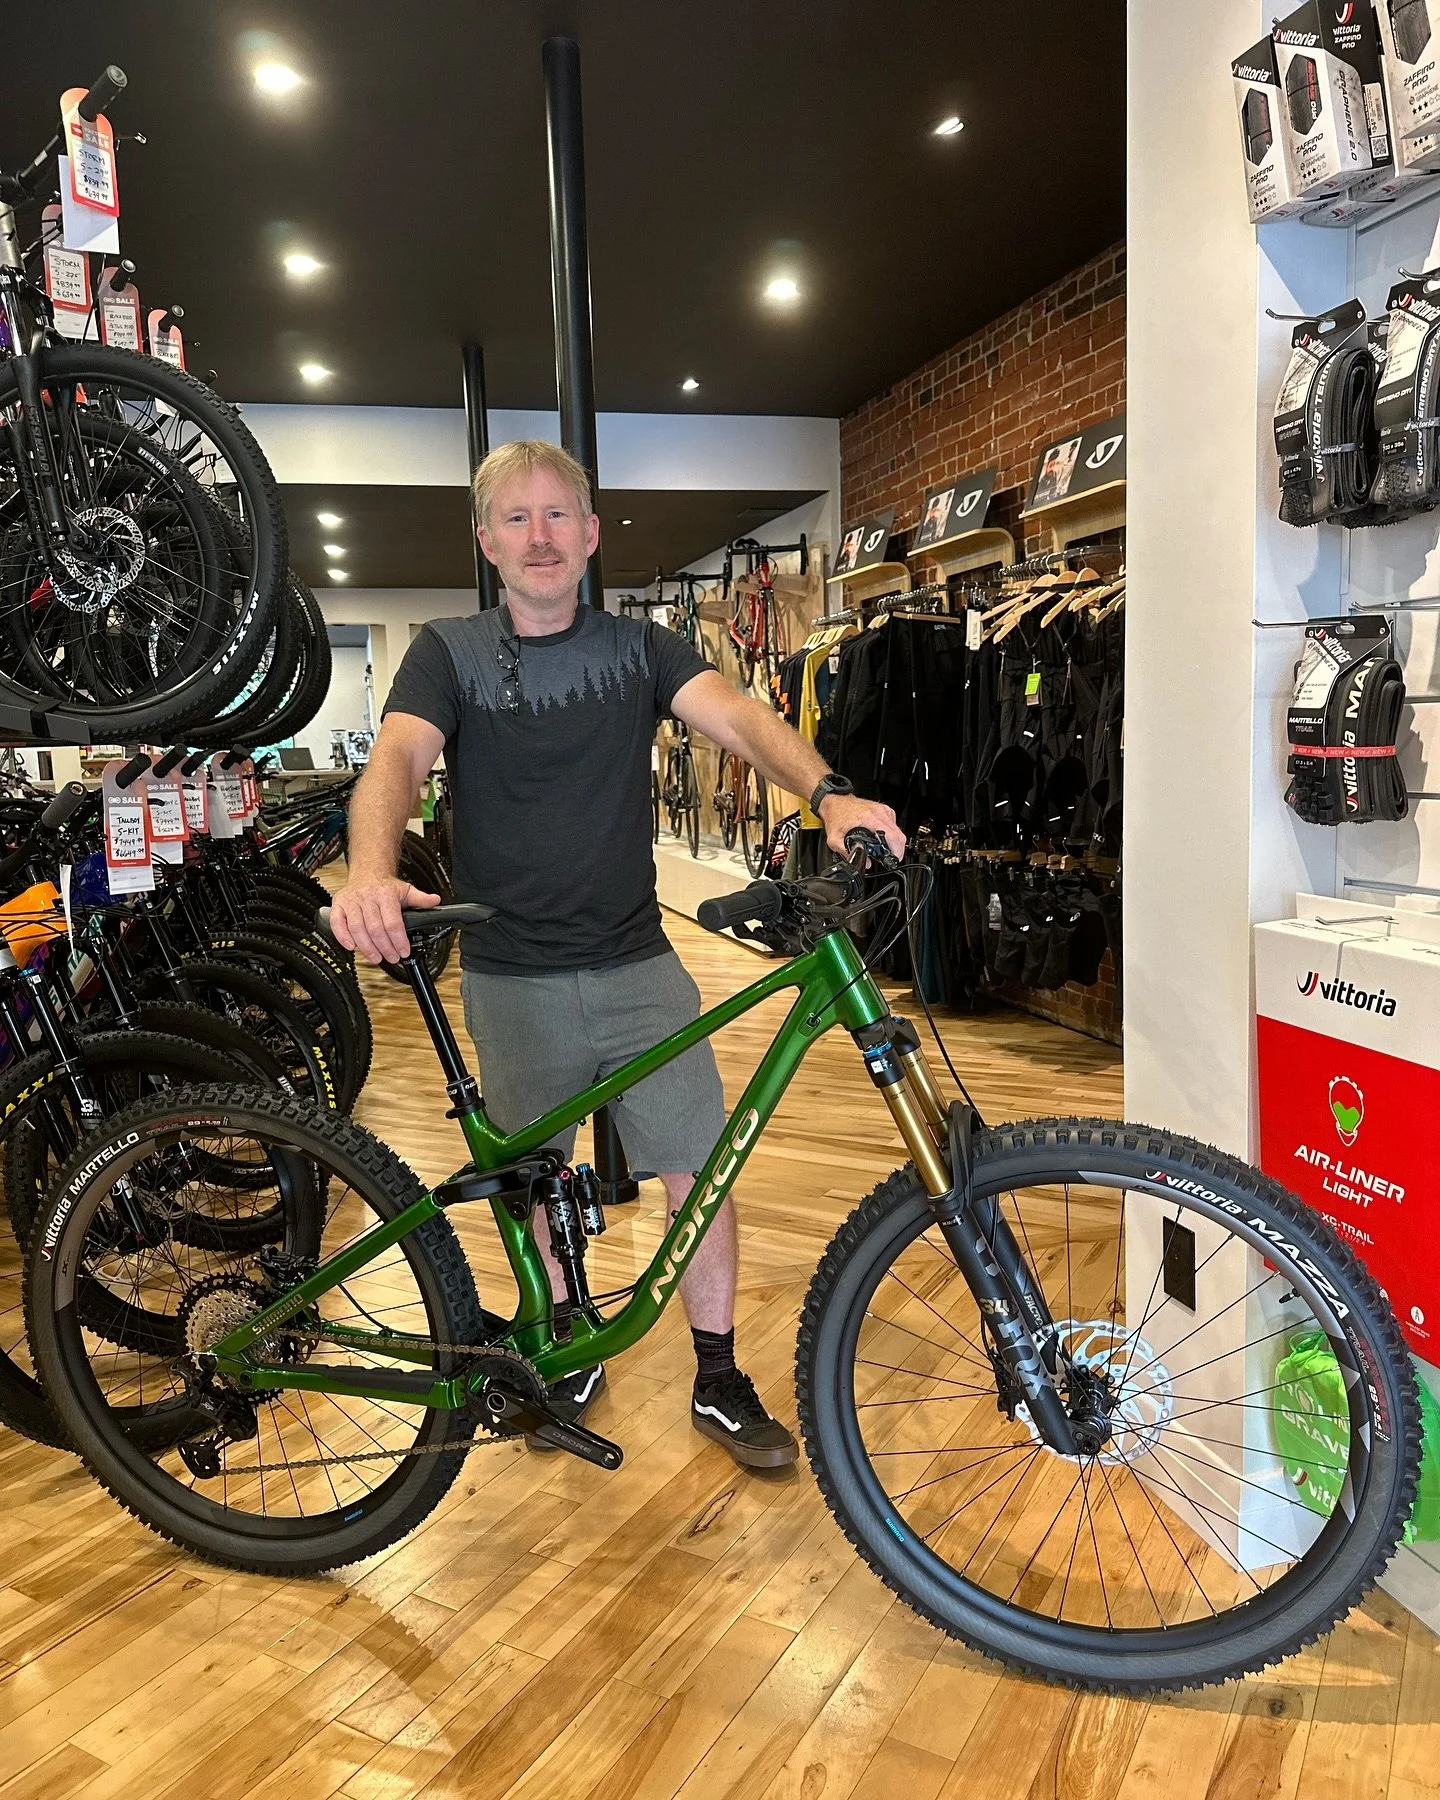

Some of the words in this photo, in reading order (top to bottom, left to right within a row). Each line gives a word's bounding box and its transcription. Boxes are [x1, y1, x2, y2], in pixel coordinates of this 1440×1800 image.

[1281, 30, 1318, 46] vittoria
[1333, 24, 1361, 35] vittoria
[1335, 34, 1362, 44] ZAFFINO
[1238, 66, 1270, 82] vittoria
[1404, 62, 1436, 86] ZAFFINO
[1339, 70, 1354, 140] GRAPHENE
[86, 132, 110, 148] SALE
[1296, 133, 1324, 154] ZAFFINO
[1250, 164, 1274, 184] ZAFFINO
[212, 591, 259, 676] MAXXIS
[1322, 634, 1351, 664] vittoria
[1342, 730, 1358, 796] vittoia
[118, 827, 140, 836] S-KIT
[212, 940, 236, 950] XIS
[300, 938, 342, 974] MAXXIS
[1320, 978, 1397, 1016] vittoria
[312, 1046, 336, 1108] MAXXIS
[1294, 1144, 1406, 1204] AIR-LINER
[44, 1197, 72, 1248] vittoria
[69, 1132, 140, 1196] MARTELLO
[1322, 1177, 1374, 1208] LIGHT
[650, 1108, 760, 1306] NORCO
[1321, 1212, 1374, 1245] XC-TRAIL
[1165, 1176, 1243, 1215] vittoria
[1248, 1218, 1350, 1319] MAZZA
[252, 1294, 304, 1335] SHIMANO
[980, 1296, 1010, 1316] 34
[997, 1316, 1054, 1400] FOX
[552, 1431, 593, 1454] DEORE
